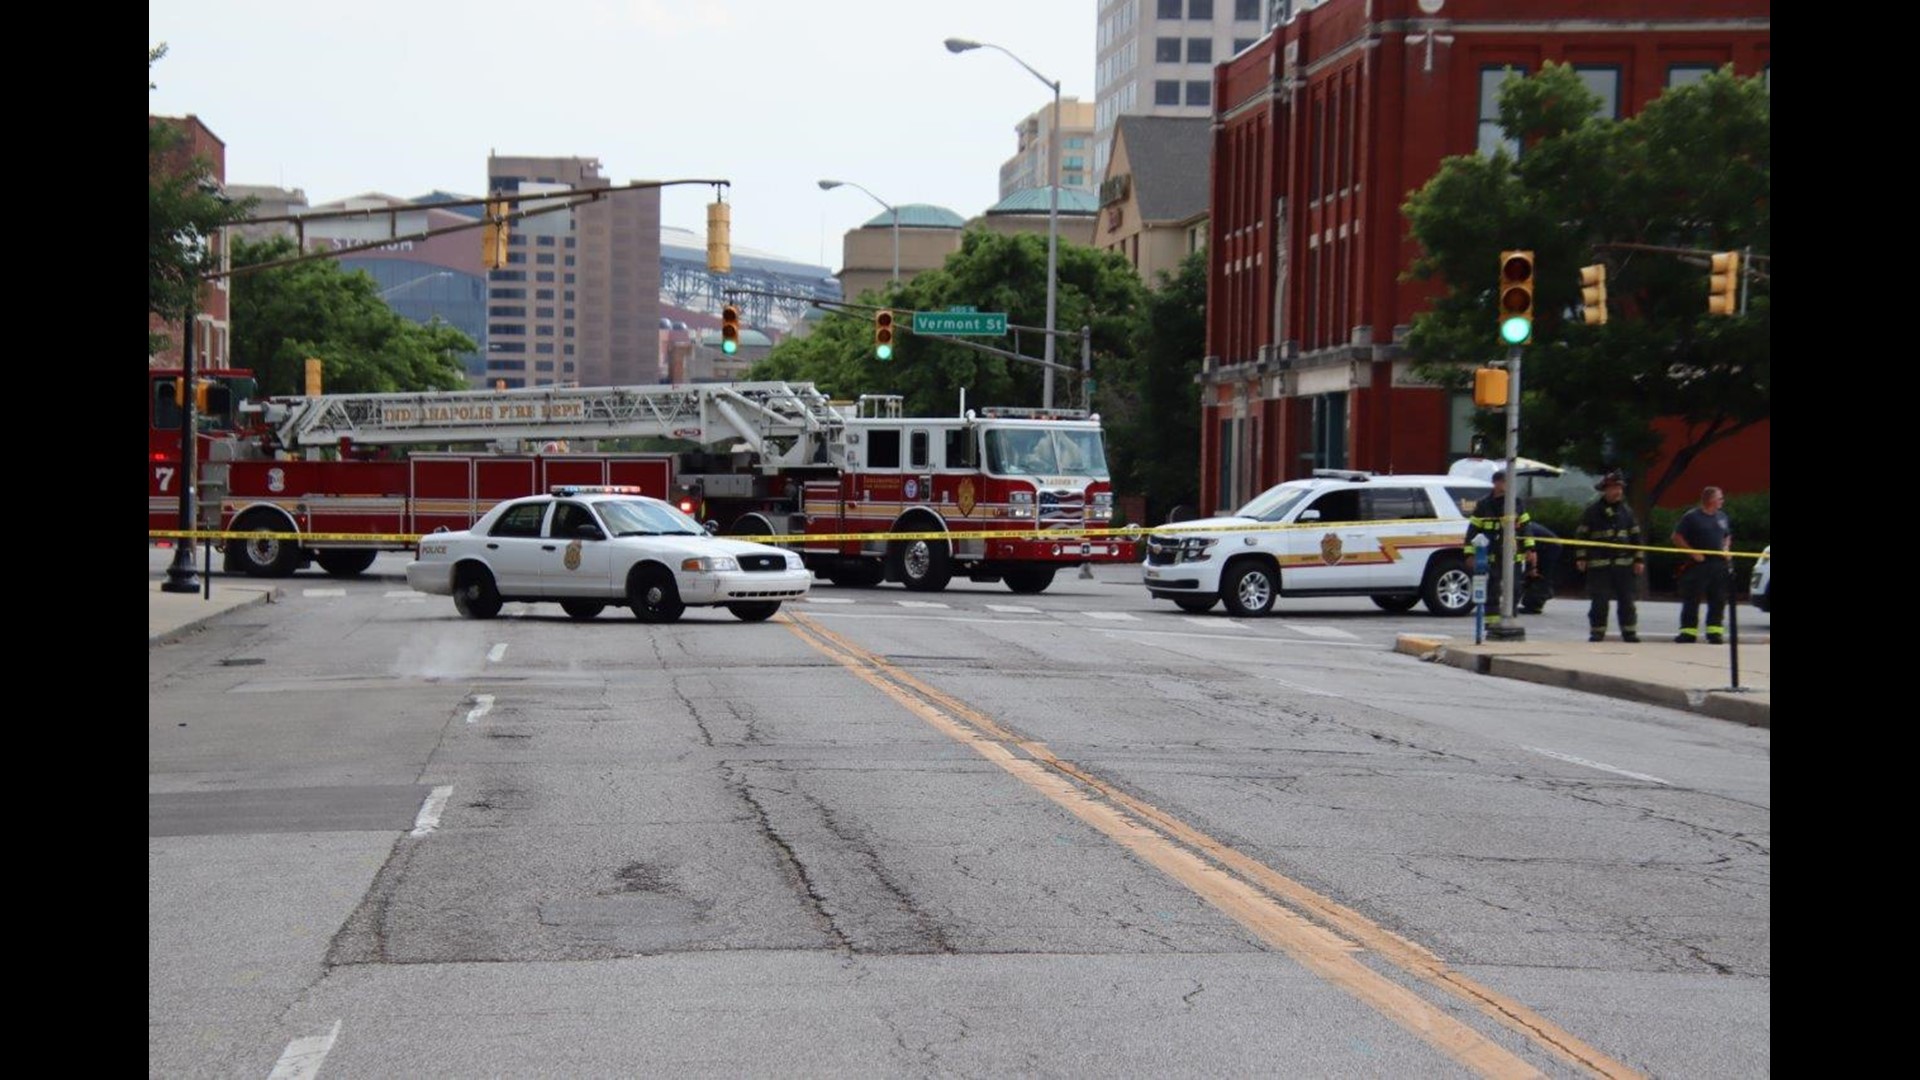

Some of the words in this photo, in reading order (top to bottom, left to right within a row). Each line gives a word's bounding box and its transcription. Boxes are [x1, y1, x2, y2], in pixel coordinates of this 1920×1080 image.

[332, 236, 413, 252] STAUM
[918, 317, 980, 330] Vermont
[985, 318, 1002, 330] St
[383, 405, 494, 422] INDANAPOLIS
[155, 467, 175, 491] 7
[421, 545, 447, 554] POLICE
